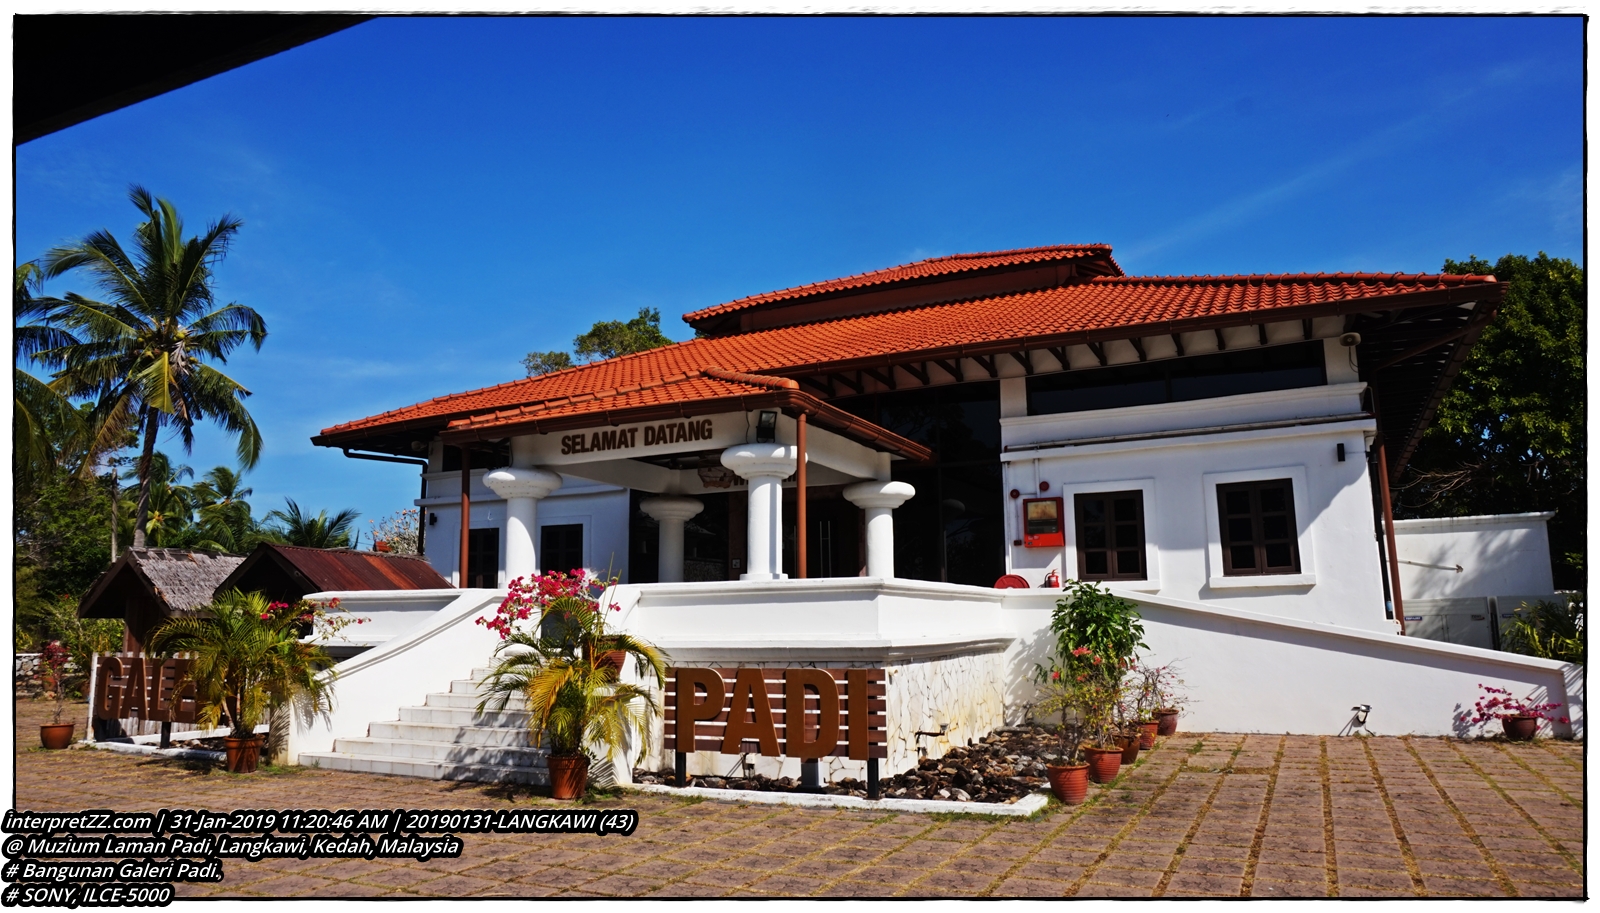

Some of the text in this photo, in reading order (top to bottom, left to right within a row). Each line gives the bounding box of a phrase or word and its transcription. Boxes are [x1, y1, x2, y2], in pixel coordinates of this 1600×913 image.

[561, 418, 713, 455] SELAMAT DATANG
[675, 667, 869, 761] PADI
